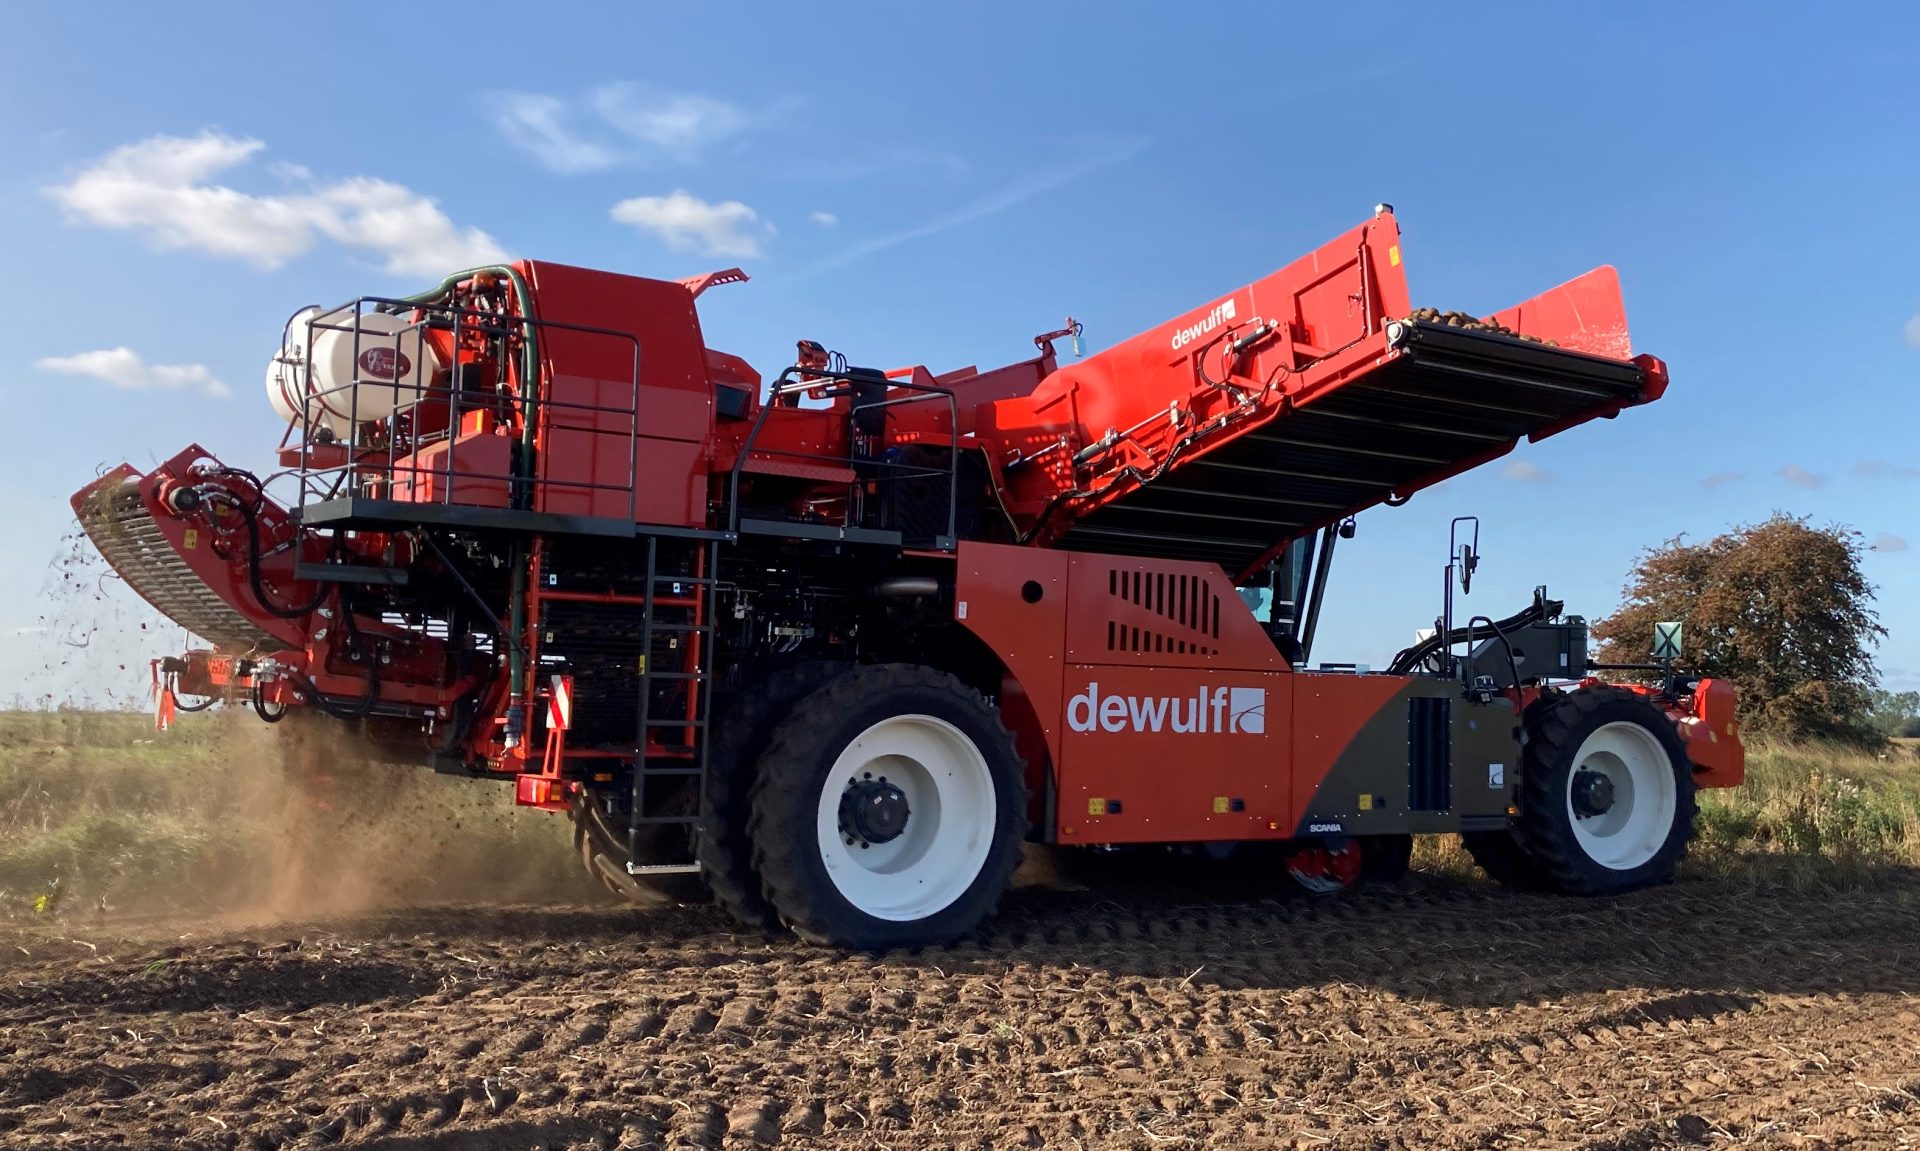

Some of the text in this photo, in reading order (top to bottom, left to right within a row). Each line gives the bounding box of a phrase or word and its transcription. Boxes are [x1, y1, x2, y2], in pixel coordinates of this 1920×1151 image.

[1171, 306, 1221, 350] dewulf
[1067, 682, 1228, 733] dewulf
[1310, 824, 1341, 832] SCANIA
